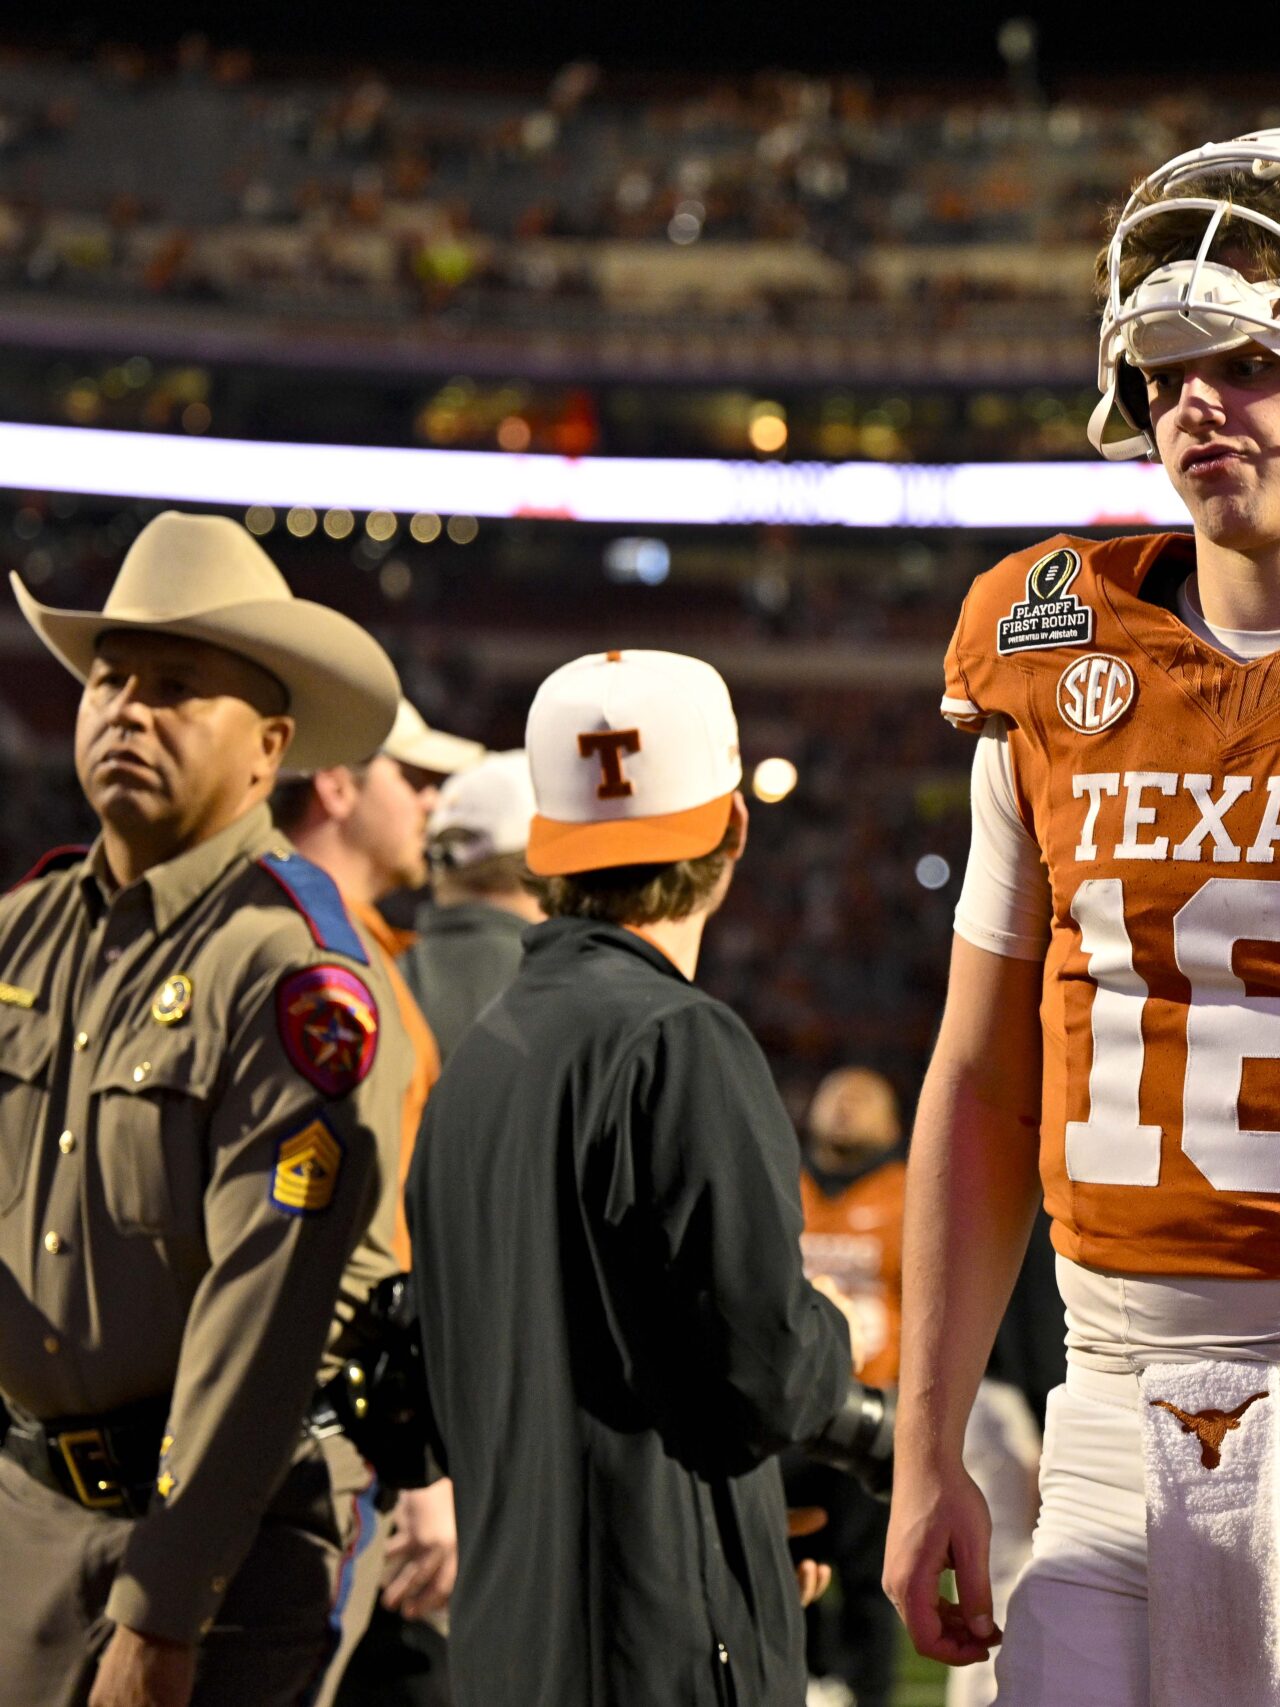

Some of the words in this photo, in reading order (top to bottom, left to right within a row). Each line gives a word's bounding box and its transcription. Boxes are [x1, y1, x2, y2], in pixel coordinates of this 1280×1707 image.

[1016, 601, 1072, 619] PLAYOFF
[1002, 618, 1039, 635] FIRST
[1041, 613, 1086, 629] ROUND
[1007, 633, 1040, 645] PRESENTED
[1048, 629, 1078, 640] Allstate
[1064, 658, 1127, 727] SEC
[577, 728, 641, 800] T
